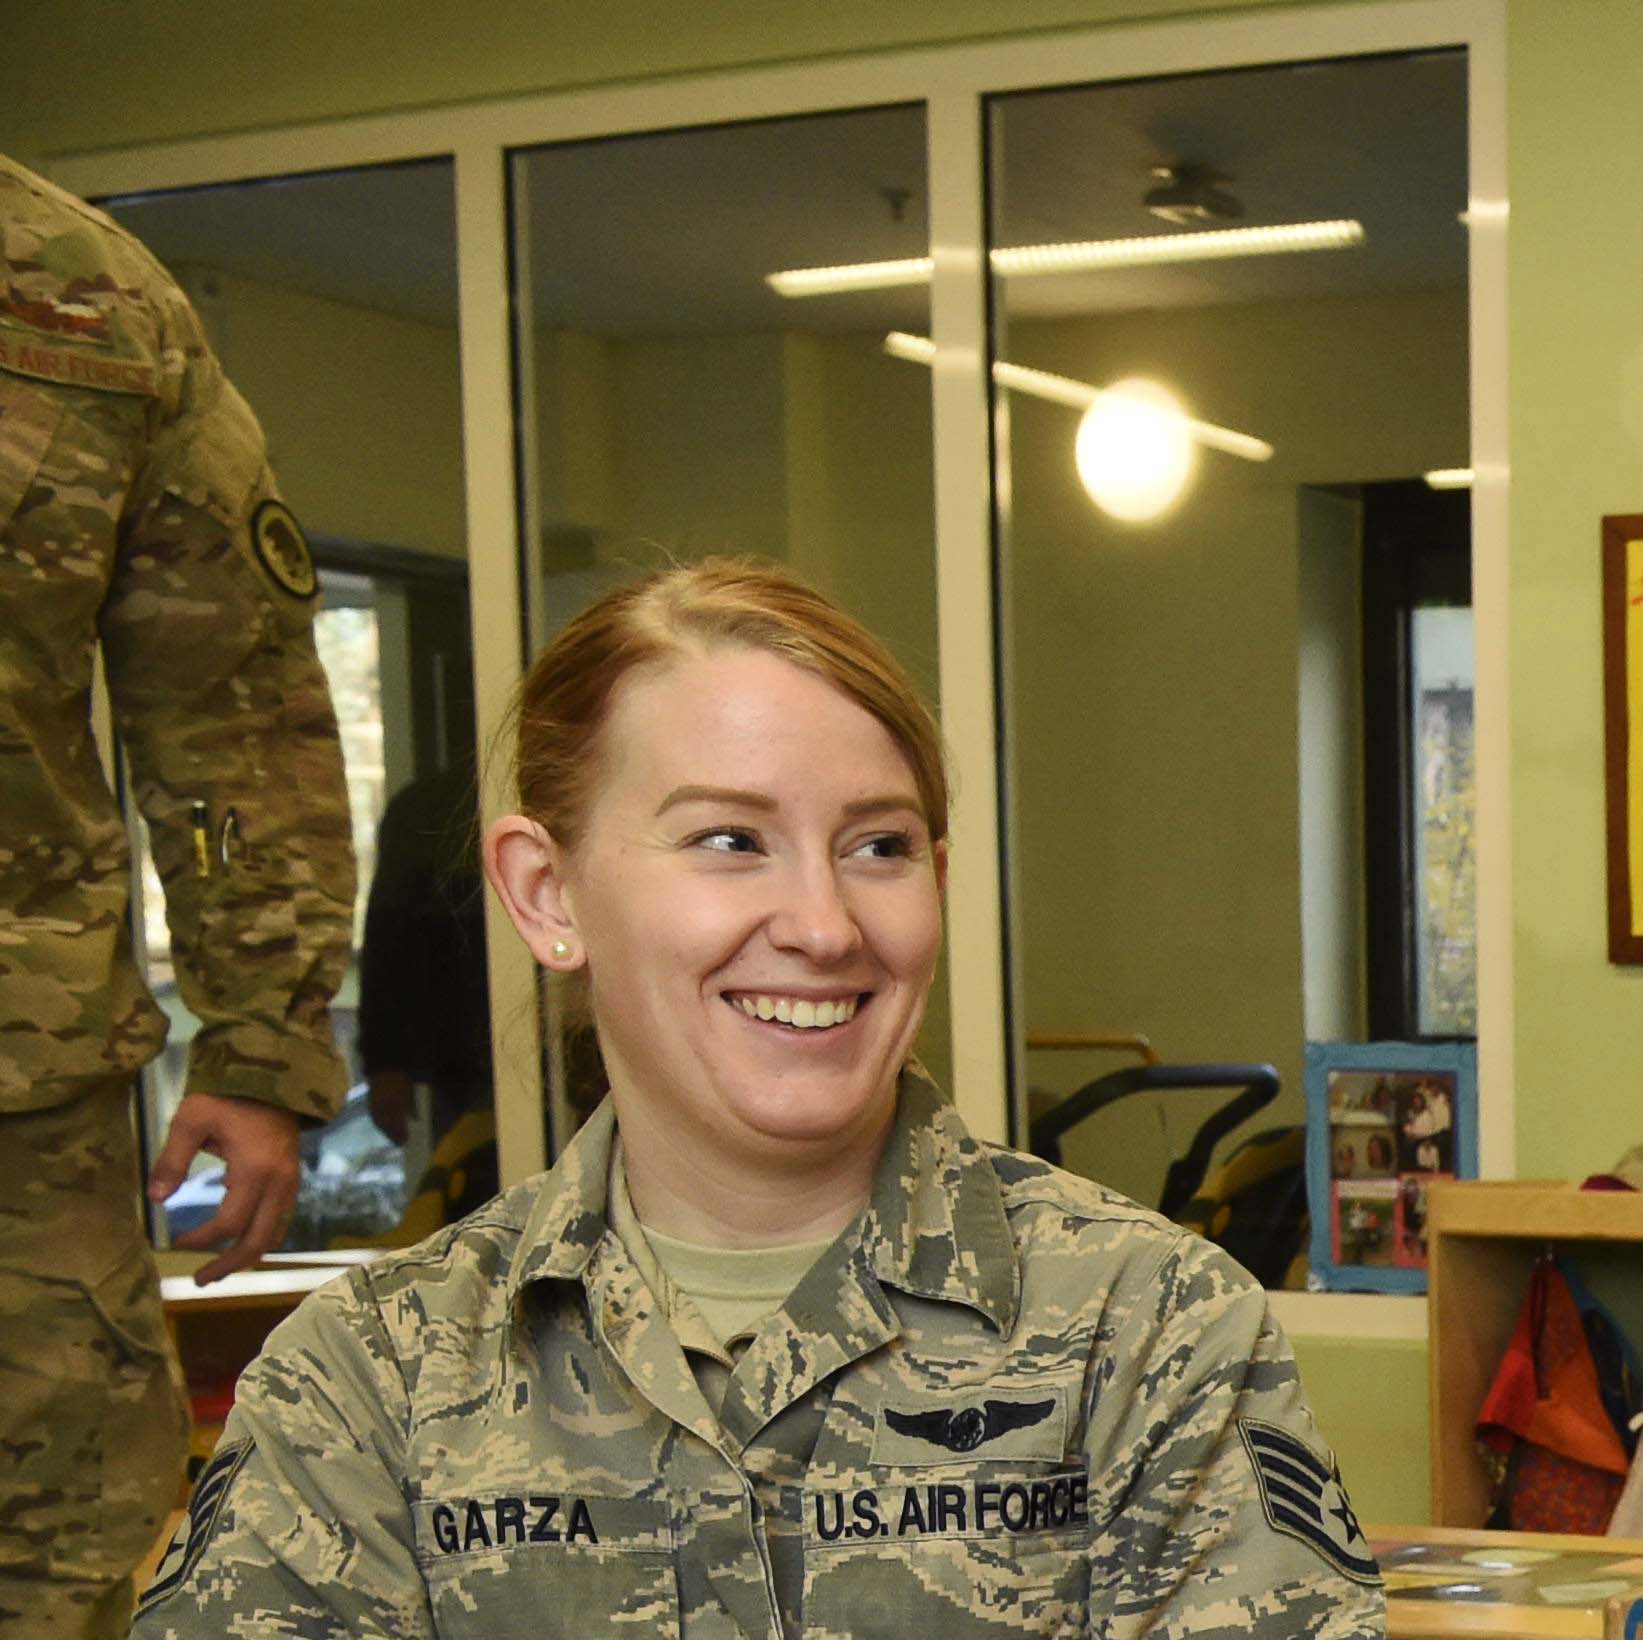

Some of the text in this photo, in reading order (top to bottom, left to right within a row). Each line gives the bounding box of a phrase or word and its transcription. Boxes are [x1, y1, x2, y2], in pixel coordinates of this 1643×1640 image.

[432, 1496, 599, 1554] GARZA
[815, 1478, 1088, 1541] U.S. AIR FORCE
